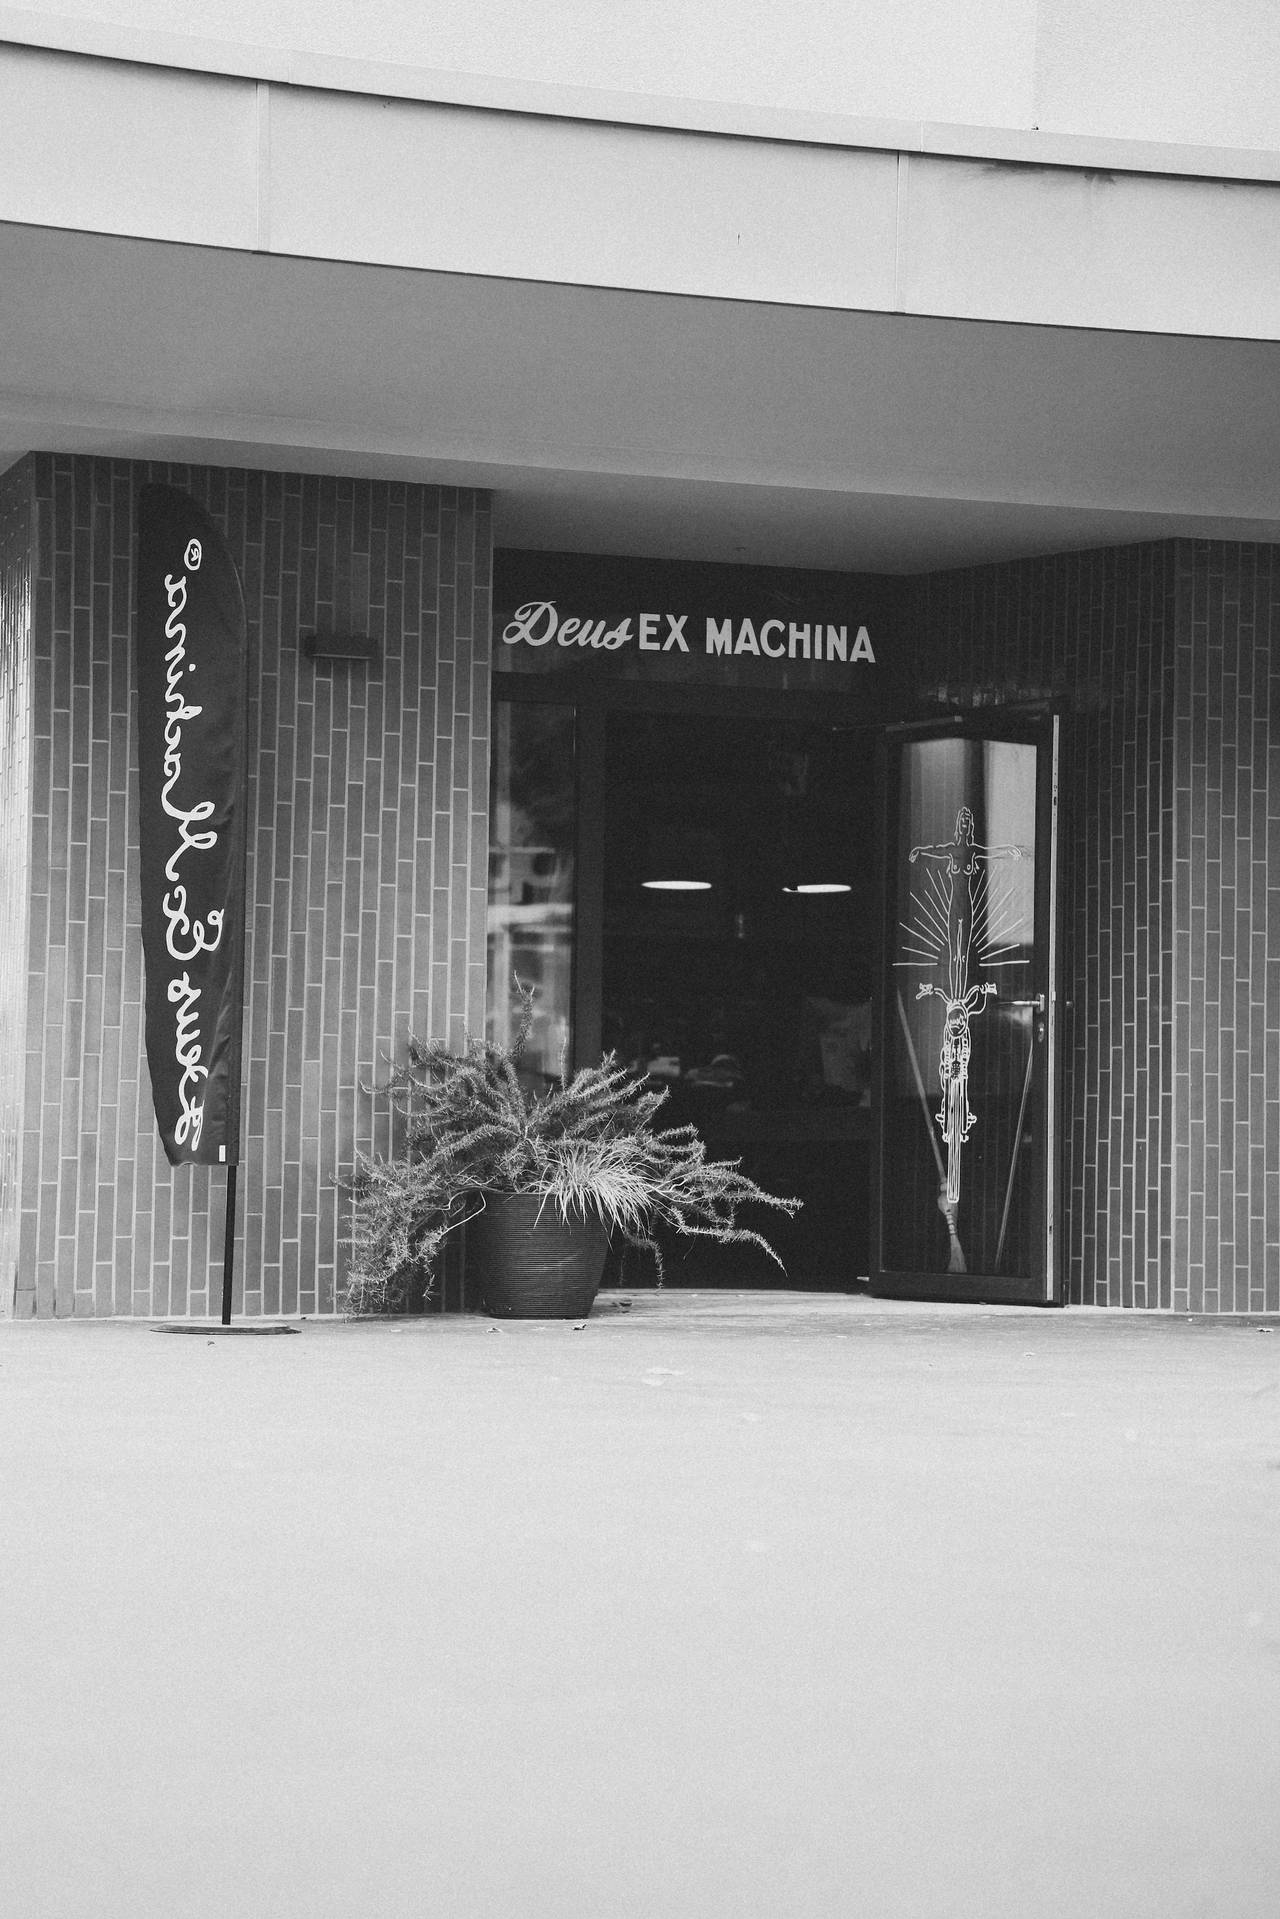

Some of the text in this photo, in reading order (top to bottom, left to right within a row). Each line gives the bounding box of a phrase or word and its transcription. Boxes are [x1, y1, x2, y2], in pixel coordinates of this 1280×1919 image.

[502, 600, 876, 663] Deus EX MACHINA
